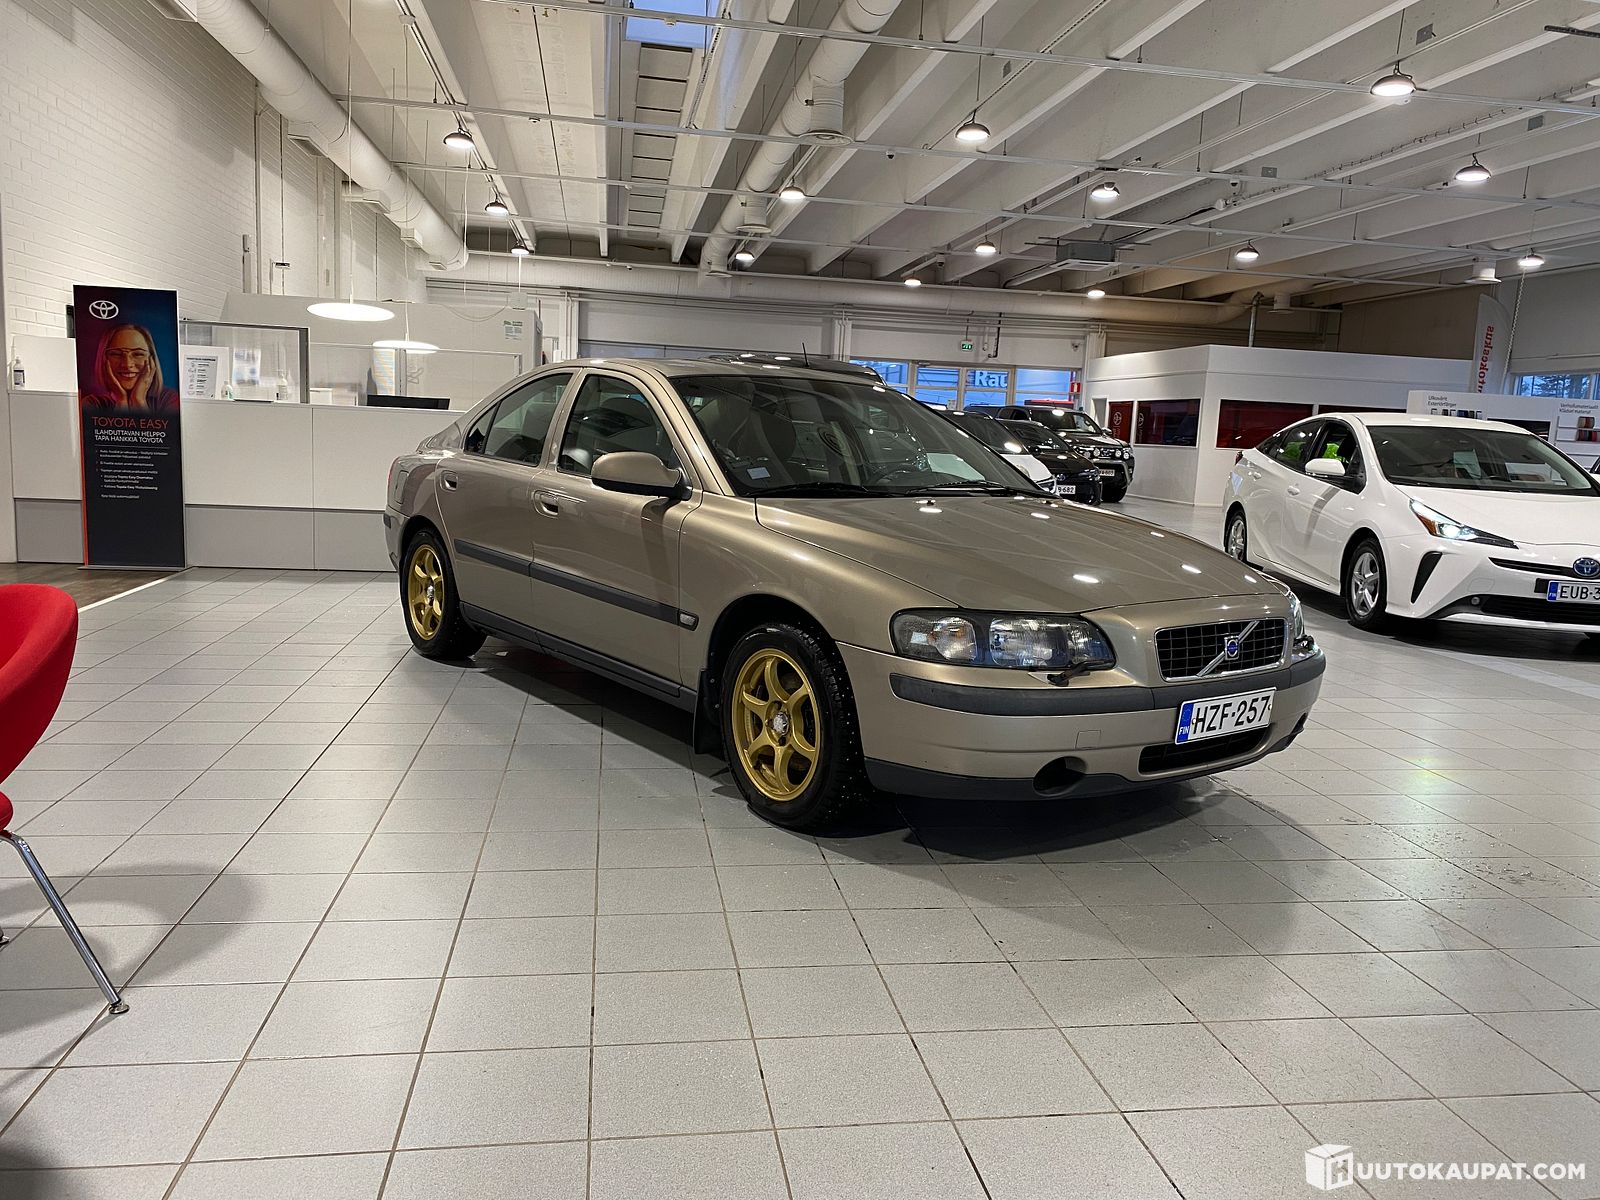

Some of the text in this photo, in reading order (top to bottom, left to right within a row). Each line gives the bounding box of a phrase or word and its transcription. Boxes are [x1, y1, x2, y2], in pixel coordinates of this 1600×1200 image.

[92, 416, 169, 429] TOYOTA EASY
[94, 429, 140, 437] ILAHDUTTAVAN
[1179, 695, 1271, 735] FIN HZF-257
